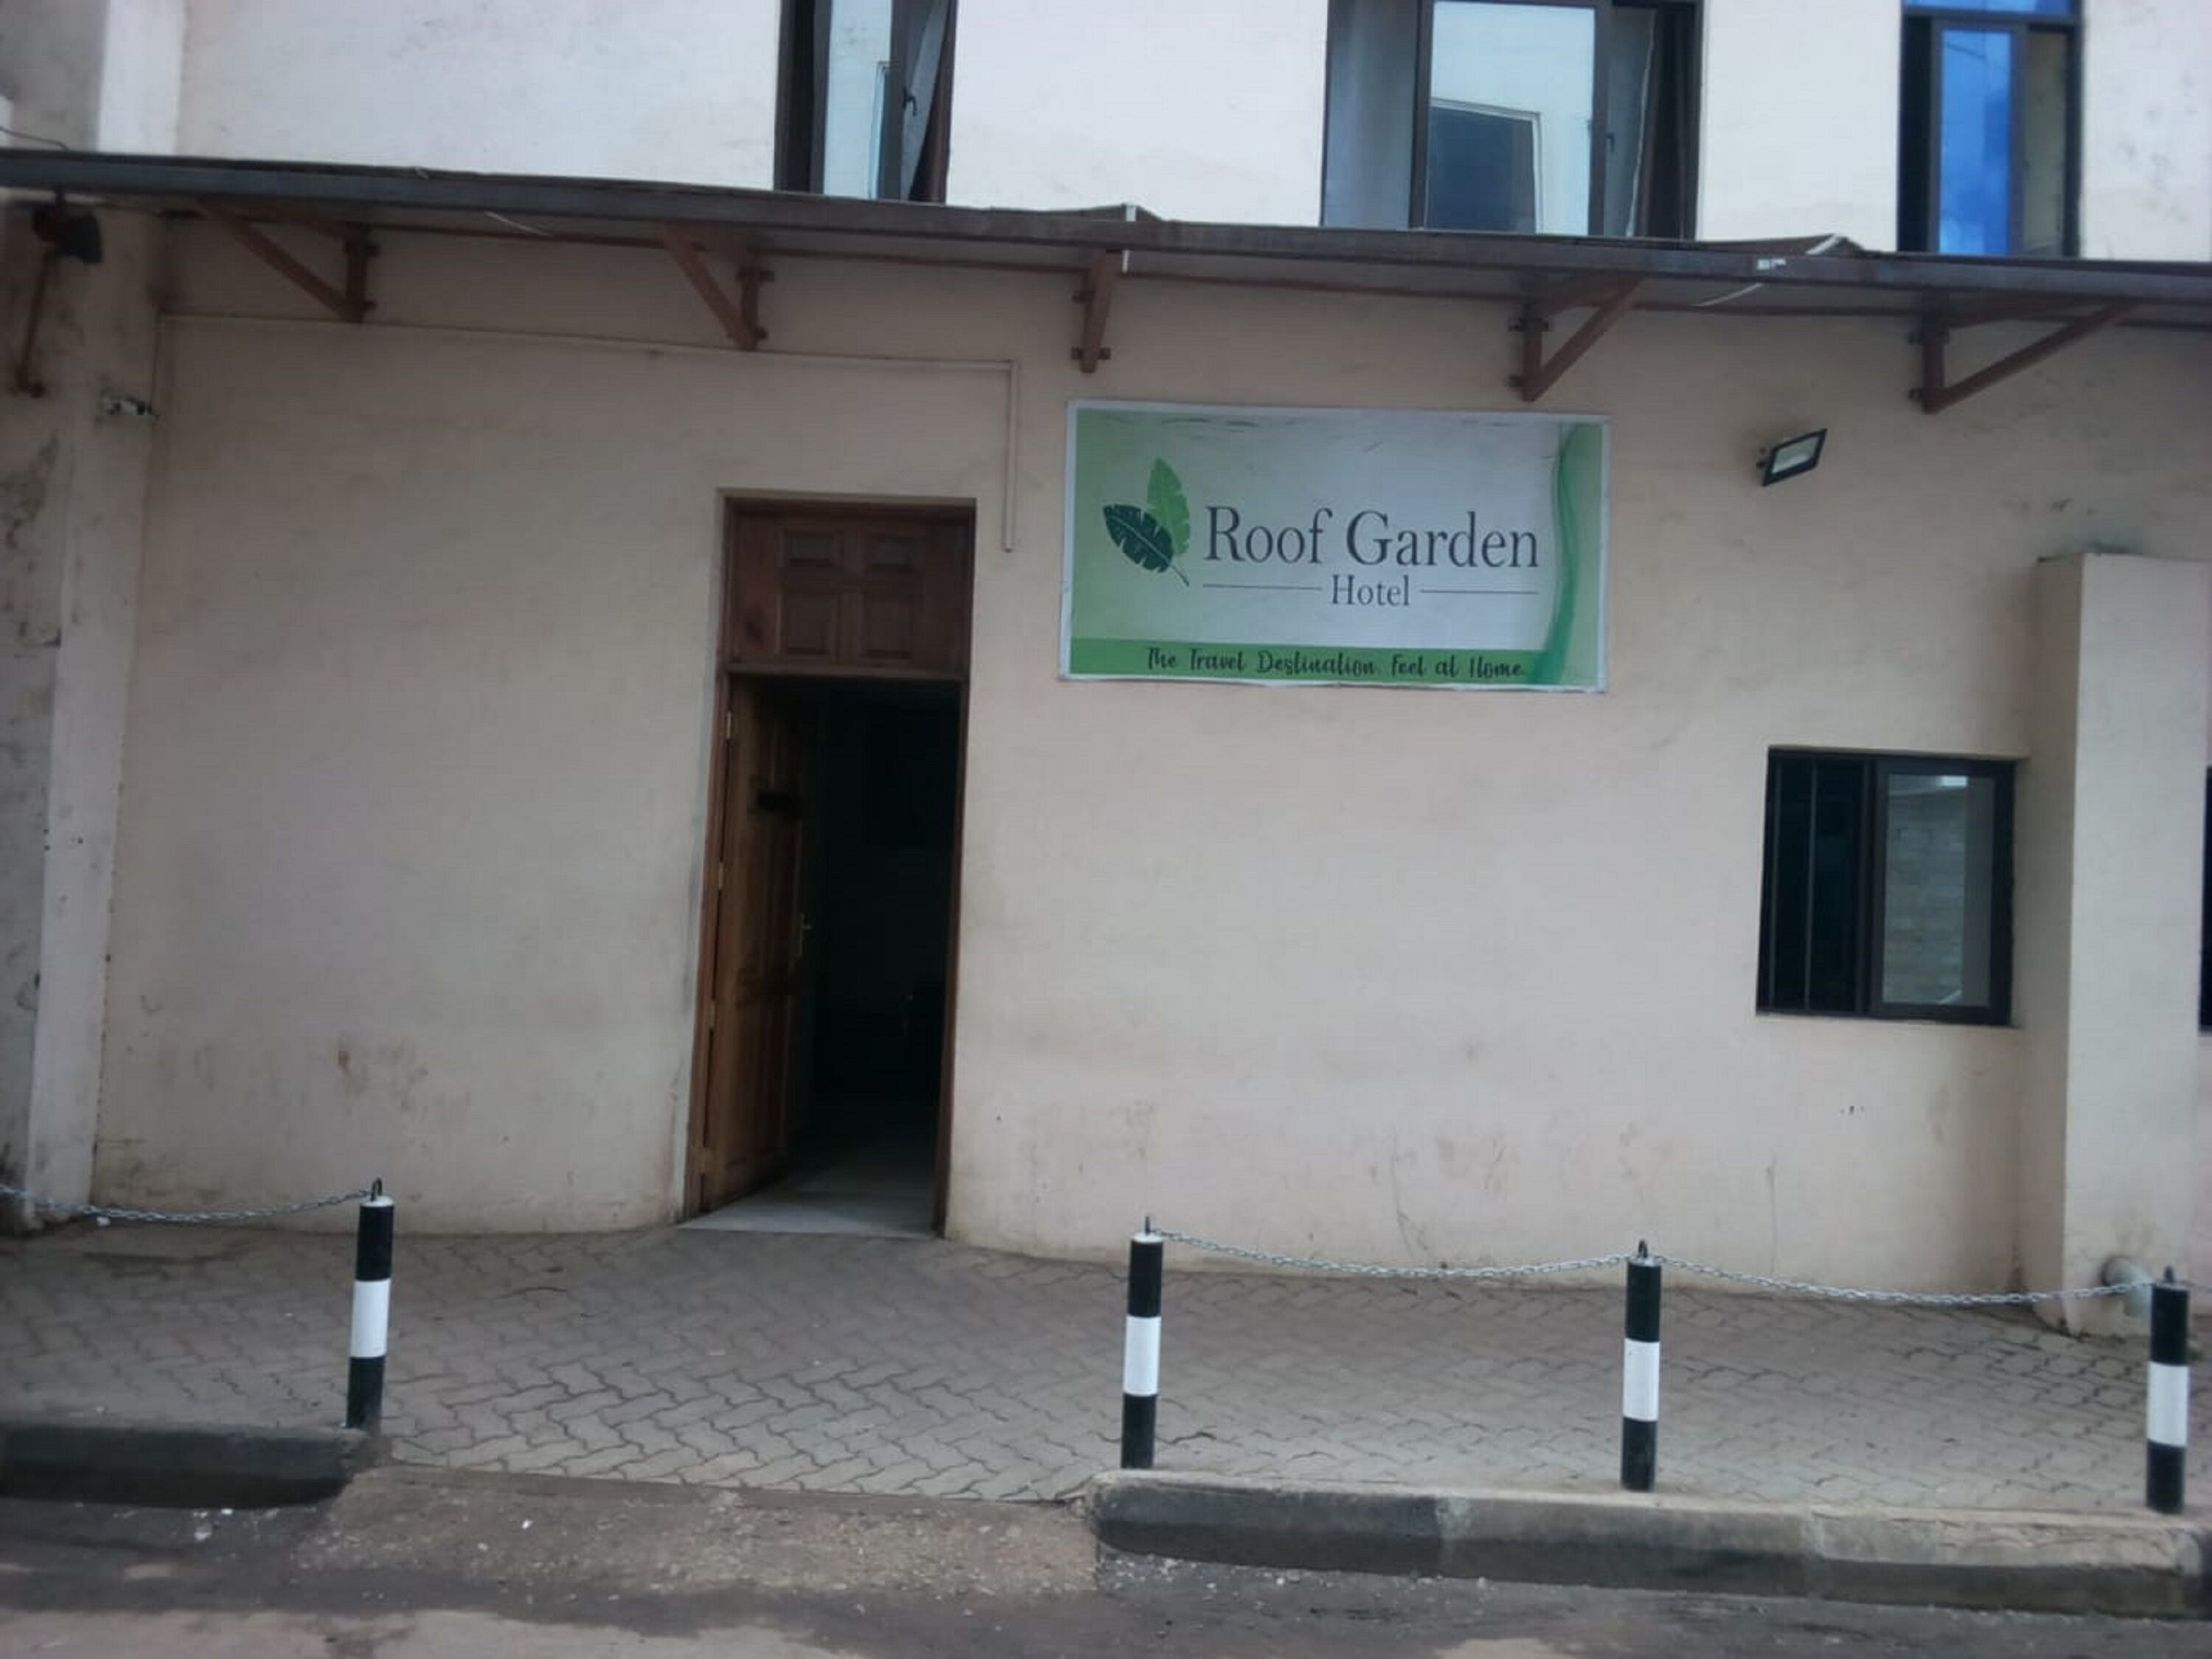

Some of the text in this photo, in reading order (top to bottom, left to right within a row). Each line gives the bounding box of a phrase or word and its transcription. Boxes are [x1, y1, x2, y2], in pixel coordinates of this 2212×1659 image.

[1203, 505, 1540, 569] Roof Garden
[1331, 574, 1411, 608] Hotel
[1148, 646, 1177, 669] The
[1189, 648, 1246, 672] Travel
[1391, 653, 1426, 678] Feel
[1435, 654, 1459, 678] at
[1470, 655, 1523, 679] Home
